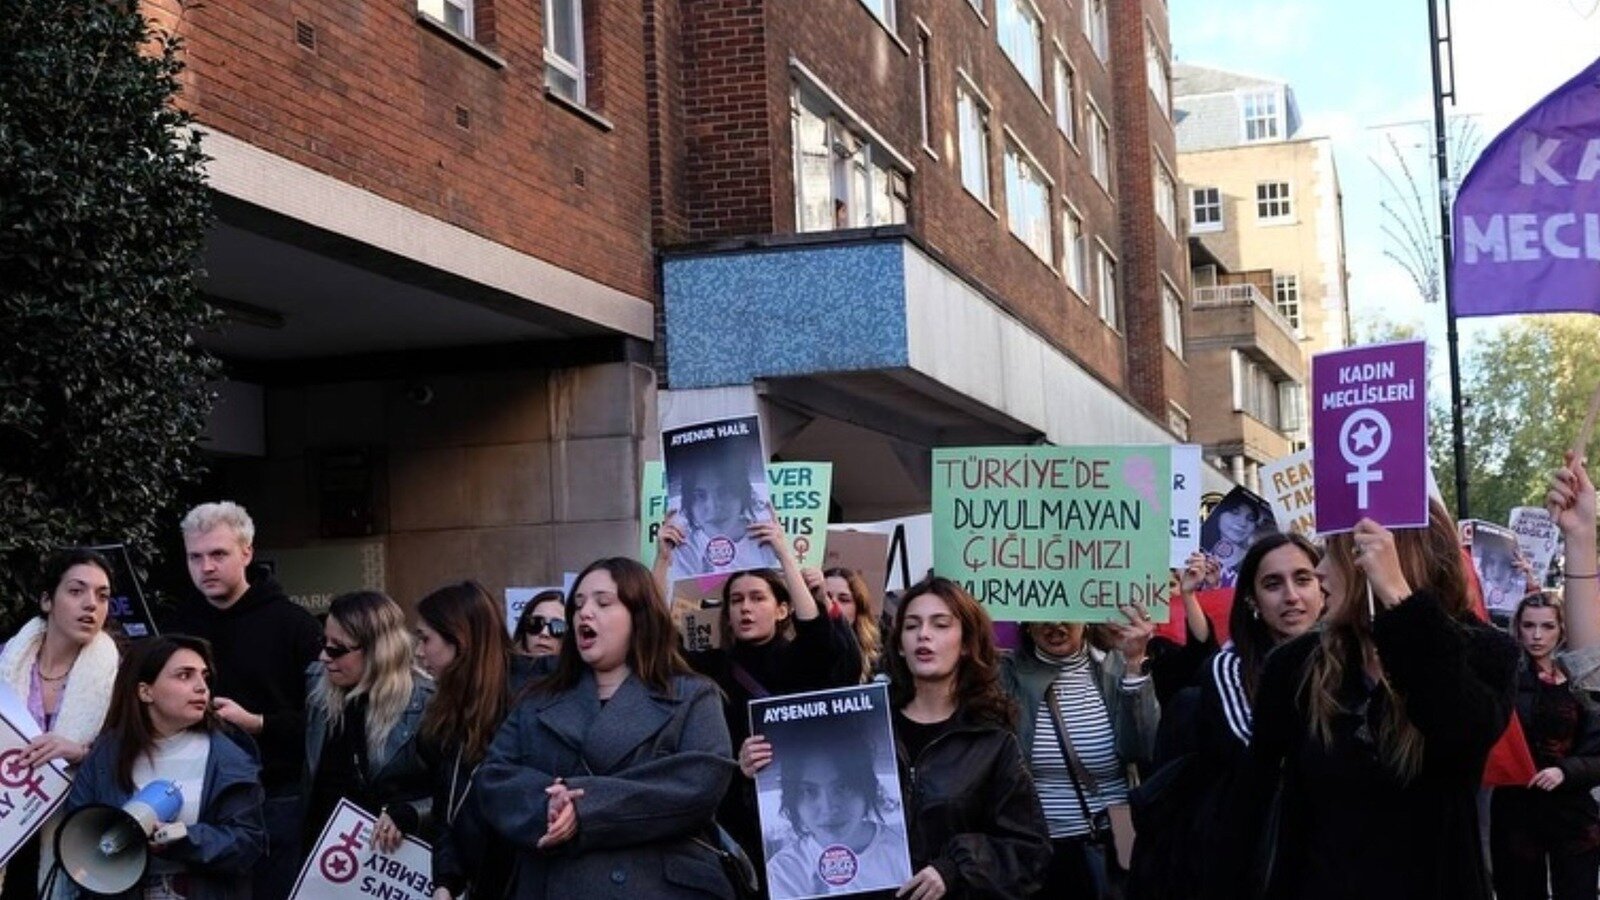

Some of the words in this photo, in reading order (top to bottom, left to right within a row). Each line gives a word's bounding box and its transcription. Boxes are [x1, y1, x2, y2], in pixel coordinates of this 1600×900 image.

[1339, 362, 1395, 384] KADIN
[1322, 379, 1415, 410] MECLİSLERİ
[936, 453, 1111, 490] TÜRKİYE'DE
[771, 491, 821, 510] LESS
[953, 497, 1141, 531] DUYULMAYAN
[962, 531, 1131, 572] ÇIĞLIĞIMIZI
[1080, 573, 1169, 608] GELDİK
[763, 701, 828, 723] AYŞENUR
[832, 693, 873, 714] HALİL
